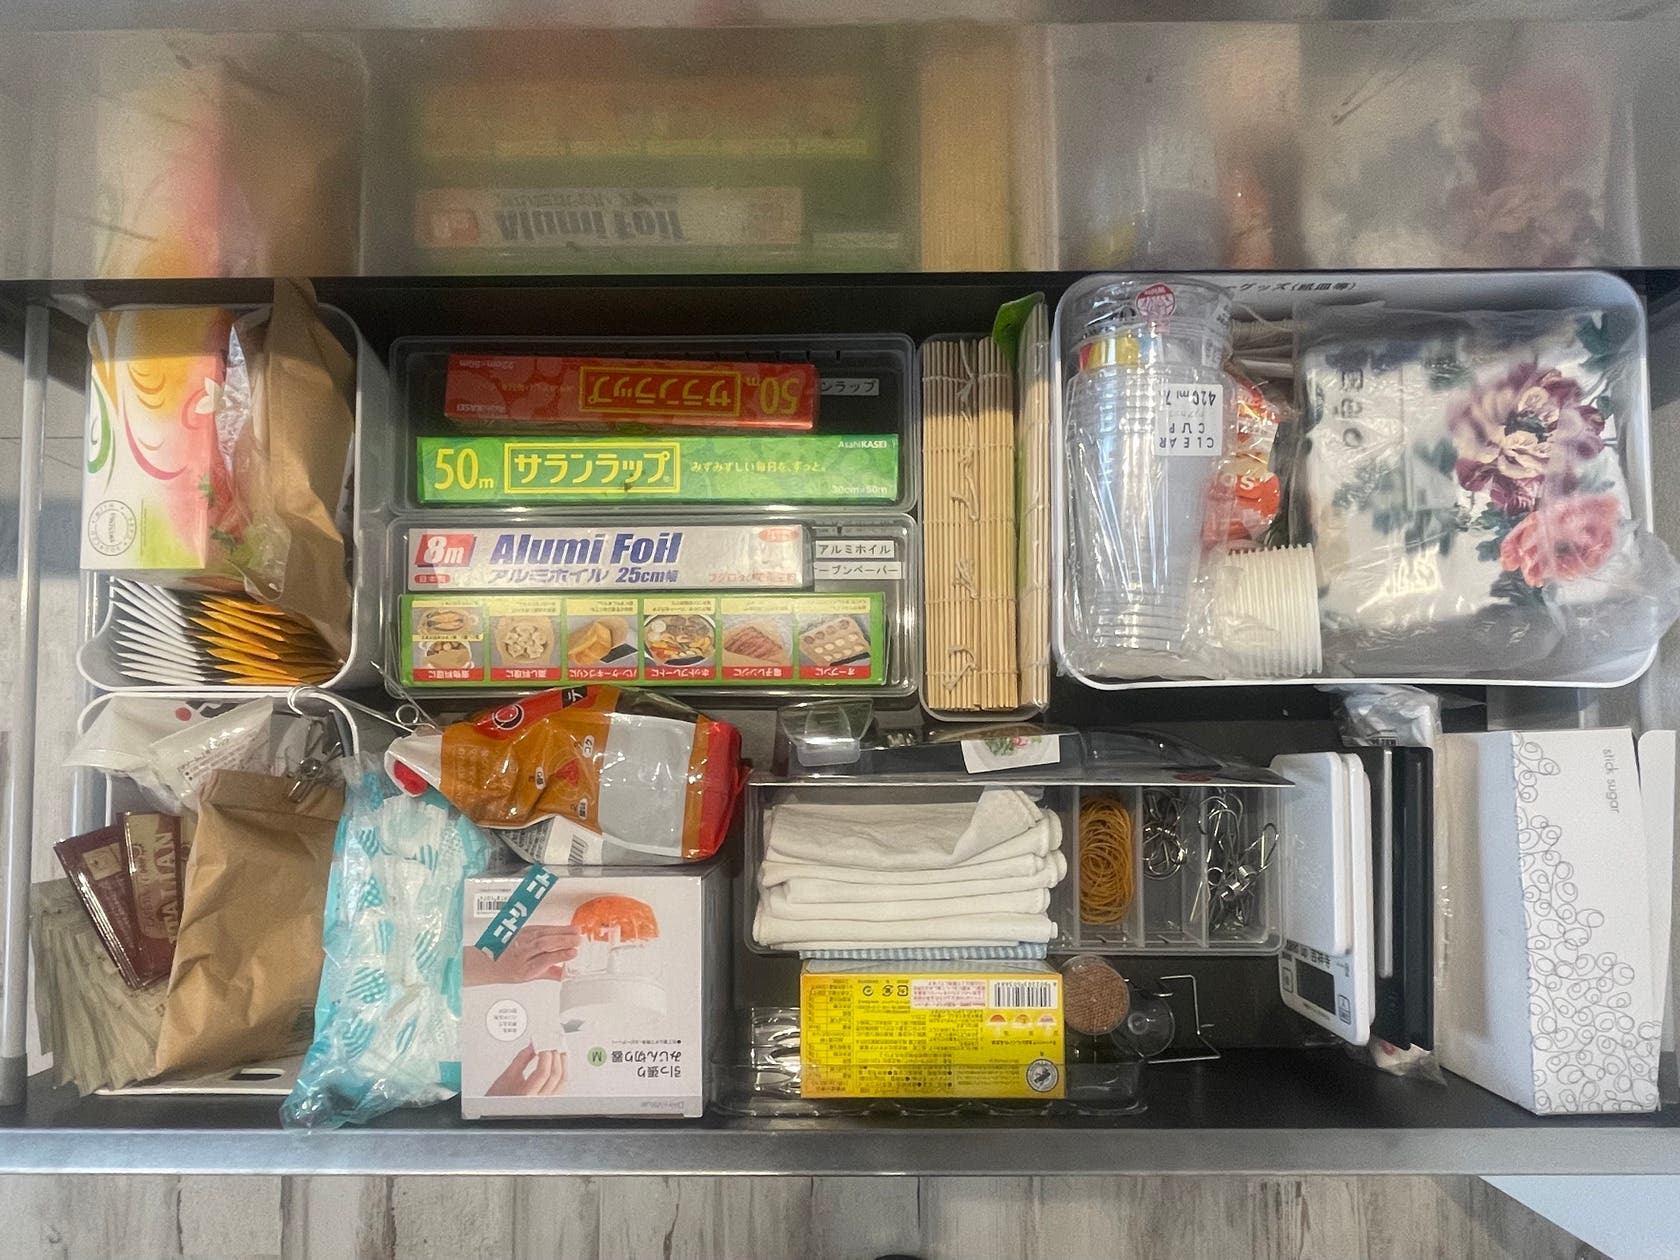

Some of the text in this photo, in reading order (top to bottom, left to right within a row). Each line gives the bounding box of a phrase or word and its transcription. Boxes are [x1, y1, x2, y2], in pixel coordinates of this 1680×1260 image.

[588, 375, 732, 408] サランラップ
[744, 376, 800, 415] 50m
[1168, 422, 1205, 434] CUP
[1159, 437, 1215, 449] CLEAR
[434, 448, 495, 490] 50m
[513, 451, 671, 485] サランラップ
[422, 535, 465, 565] 8m
[488, 531, 684, 565] Alumi Foil
[819, 543, 892, 556] アルミホイル
[487, 567, 608, 585] アルミホイル
[814, 564, 899, 576] ーブンペーパー
[1606, 778, 1620, 814] sugar
[591, 1050, 682, 1064] みじん切り器 M
[636, 1066, 682, 1079] 引っ張り
